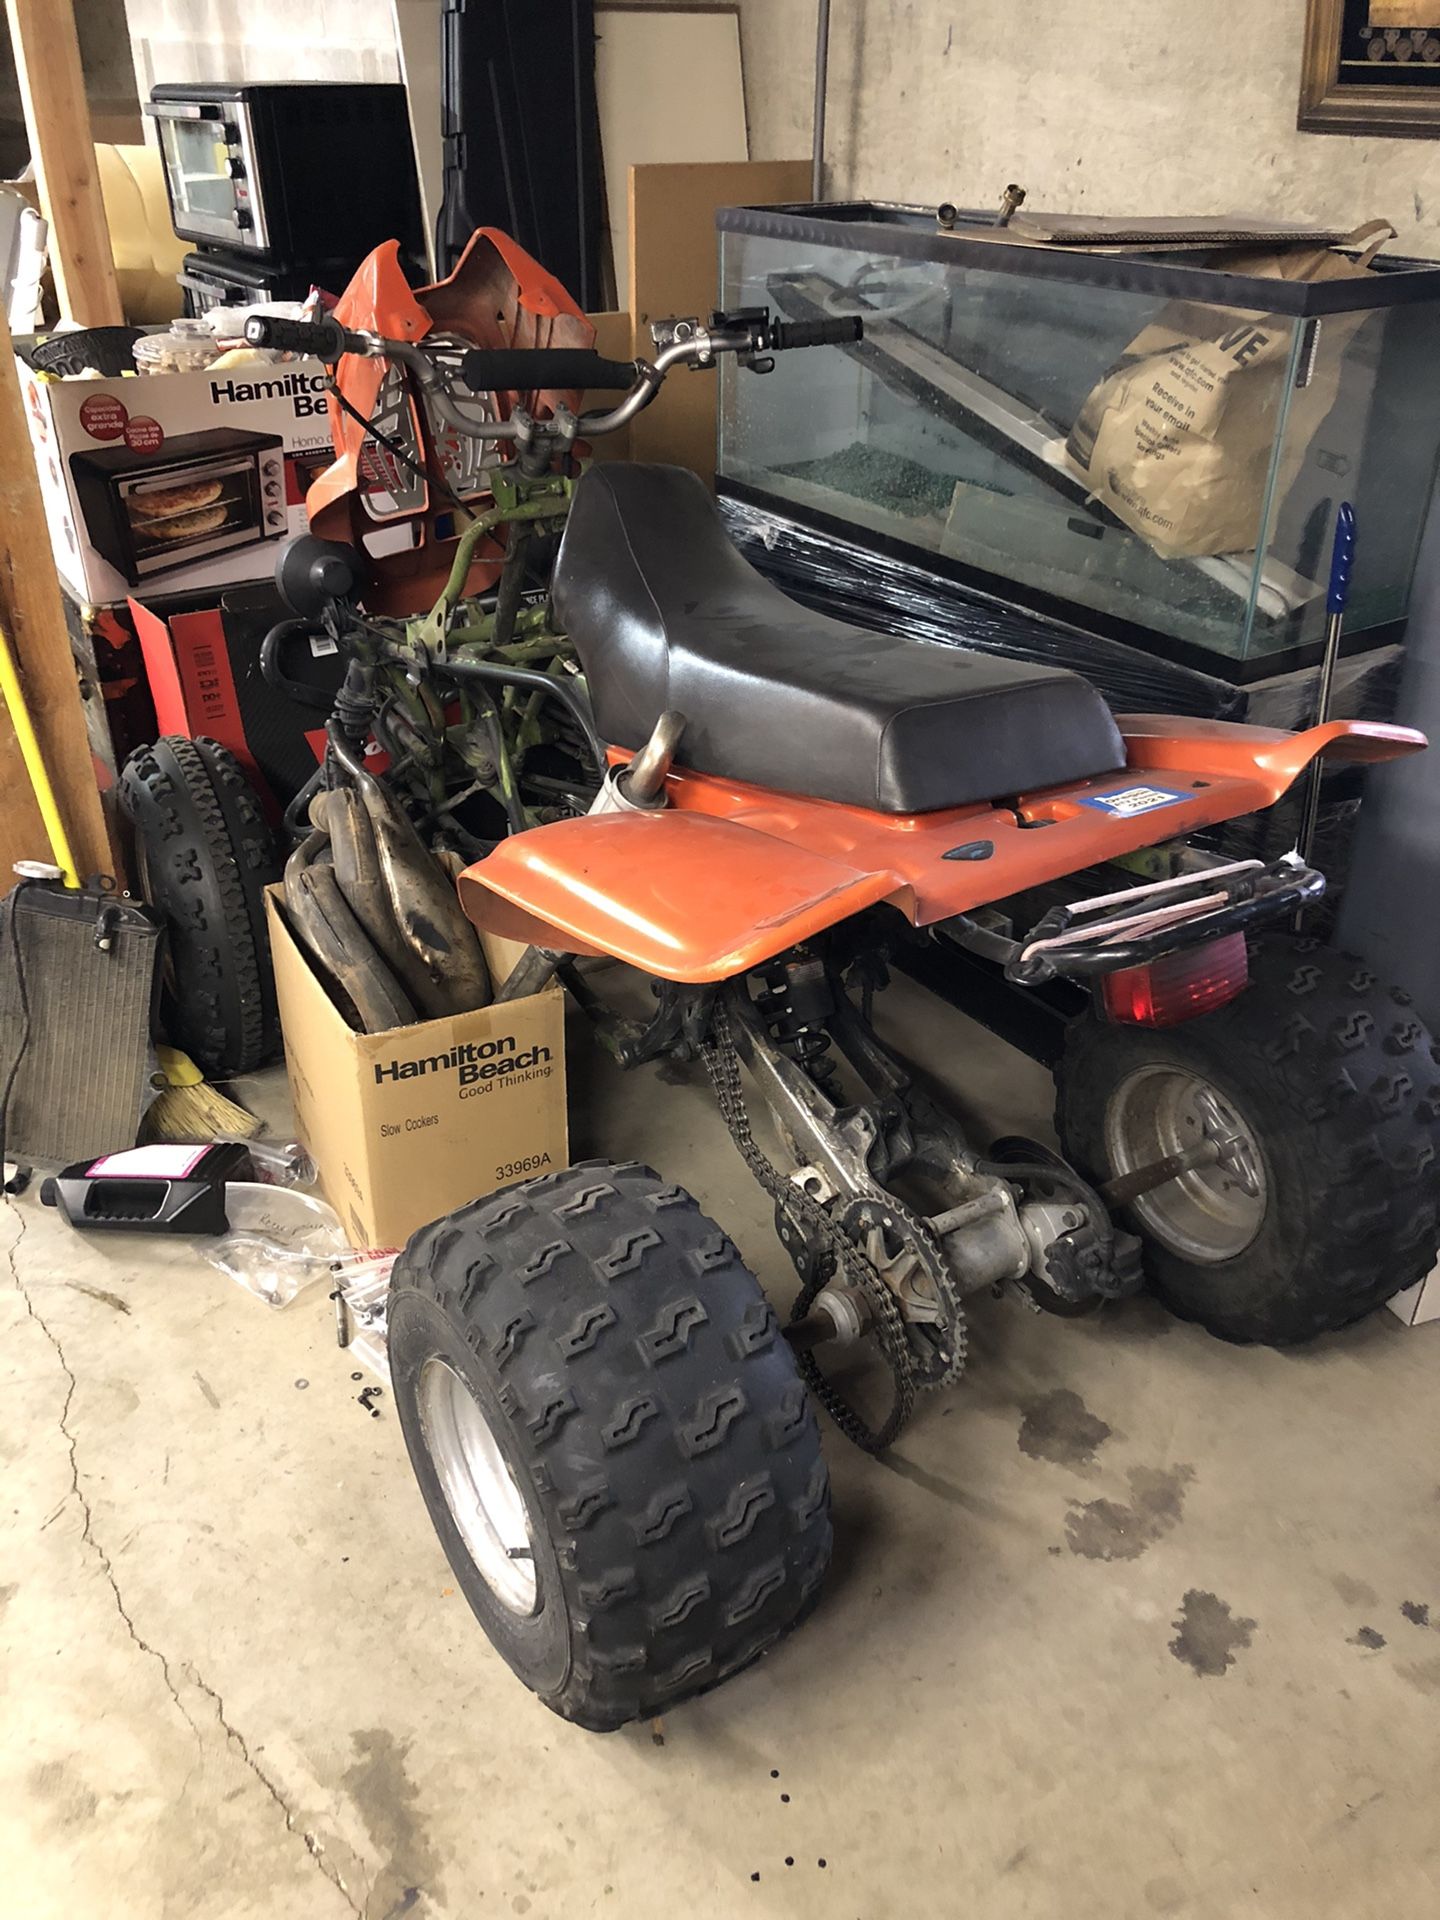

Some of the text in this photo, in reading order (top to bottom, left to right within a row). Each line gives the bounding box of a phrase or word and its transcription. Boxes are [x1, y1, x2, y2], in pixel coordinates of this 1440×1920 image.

[1219, 326, 1270, 368] VE
[210, 373, 326, 404] Hamilto
[1152, 381, 1196, 419] Receive in
[91, 413, 118, 421] extra
[293, 395, 329, 418] Be
[1145, 396, 1191, 433] your email
[87, 421, 124, 432] grande
[374, 1036, 516, 1085] Hamilton
[459, 1046, 551, 1086] Beach
[458, 1081, 493, 1100] Good
[380, 1114, 439, 1138] Slow Cookers
[495, 1152, 552, 1181] 33969A
